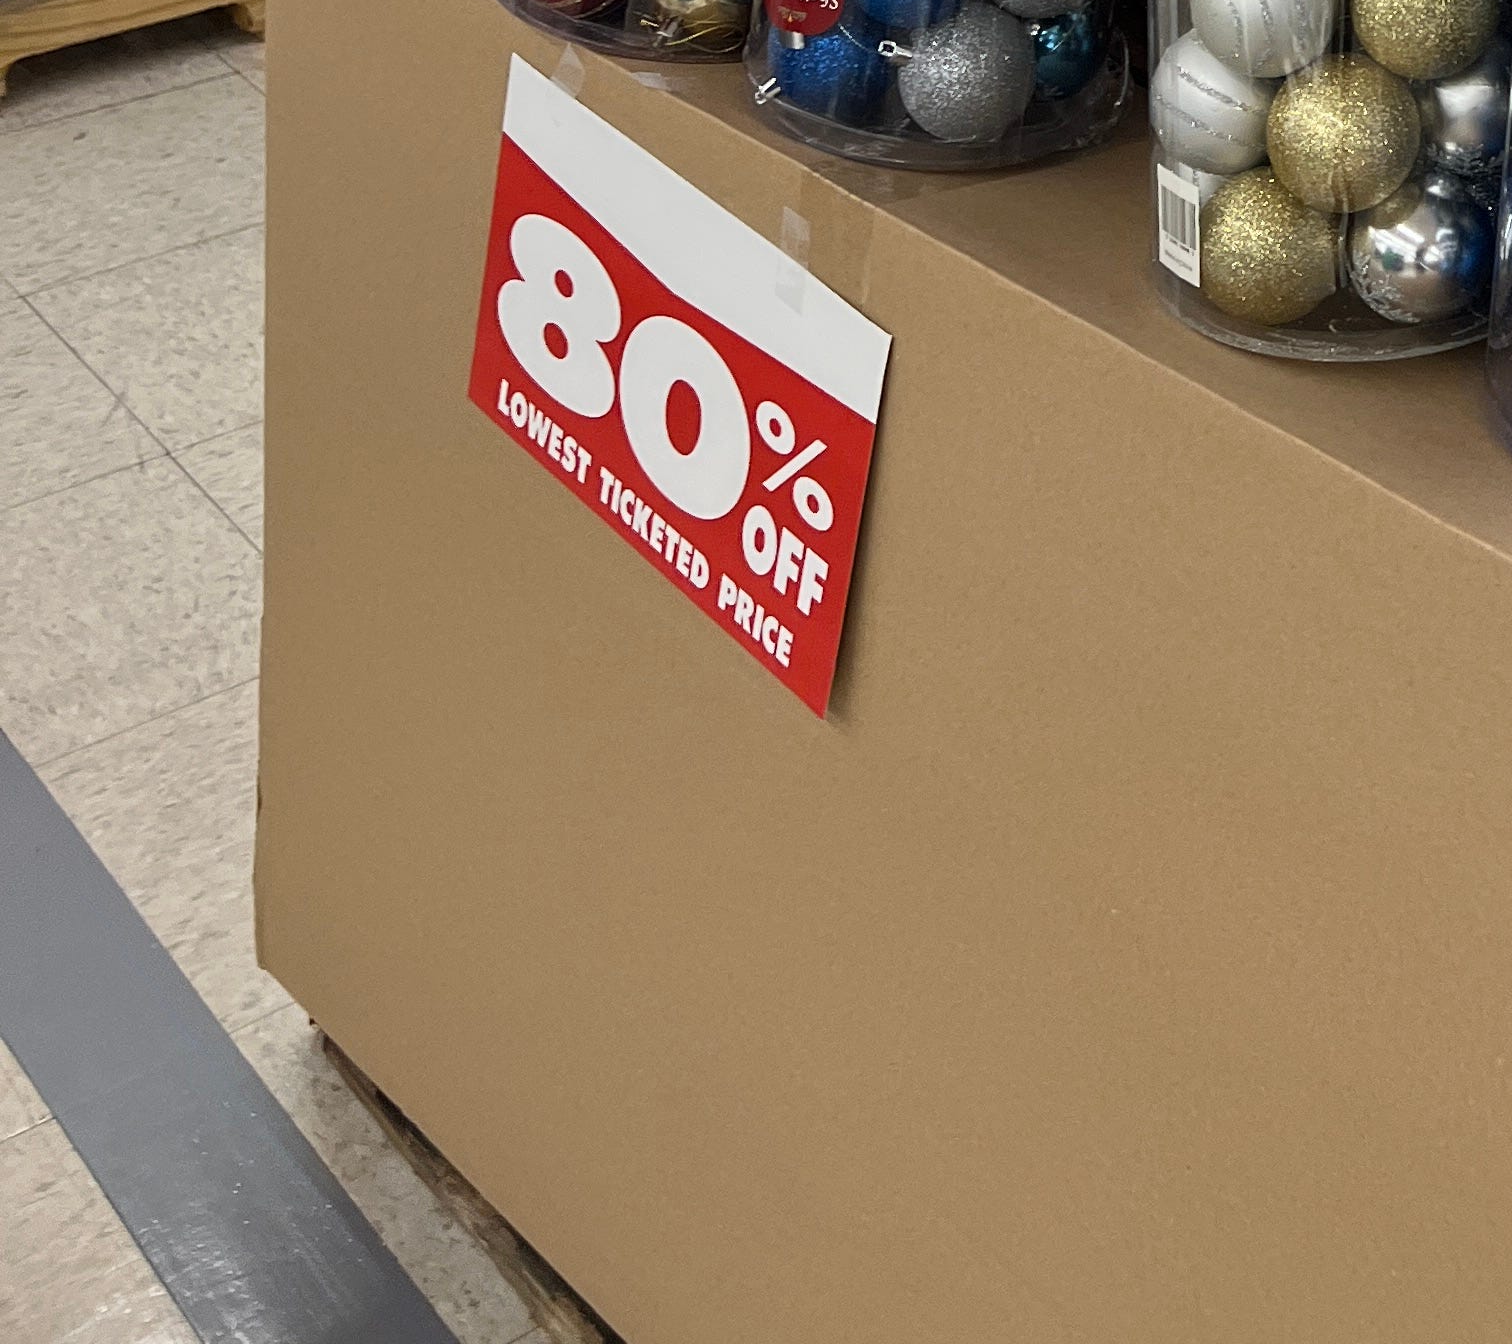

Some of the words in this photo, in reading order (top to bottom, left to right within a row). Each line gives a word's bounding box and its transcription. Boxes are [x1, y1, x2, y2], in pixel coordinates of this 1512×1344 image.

[497, 213, 834, 531] 80%
[497, 378, 593, 485] LOWEST
[600, 466, 710, 589] TICKETED
[717, 572, 794, 668] PRICE
[741, 504, 829, 616] OFF
